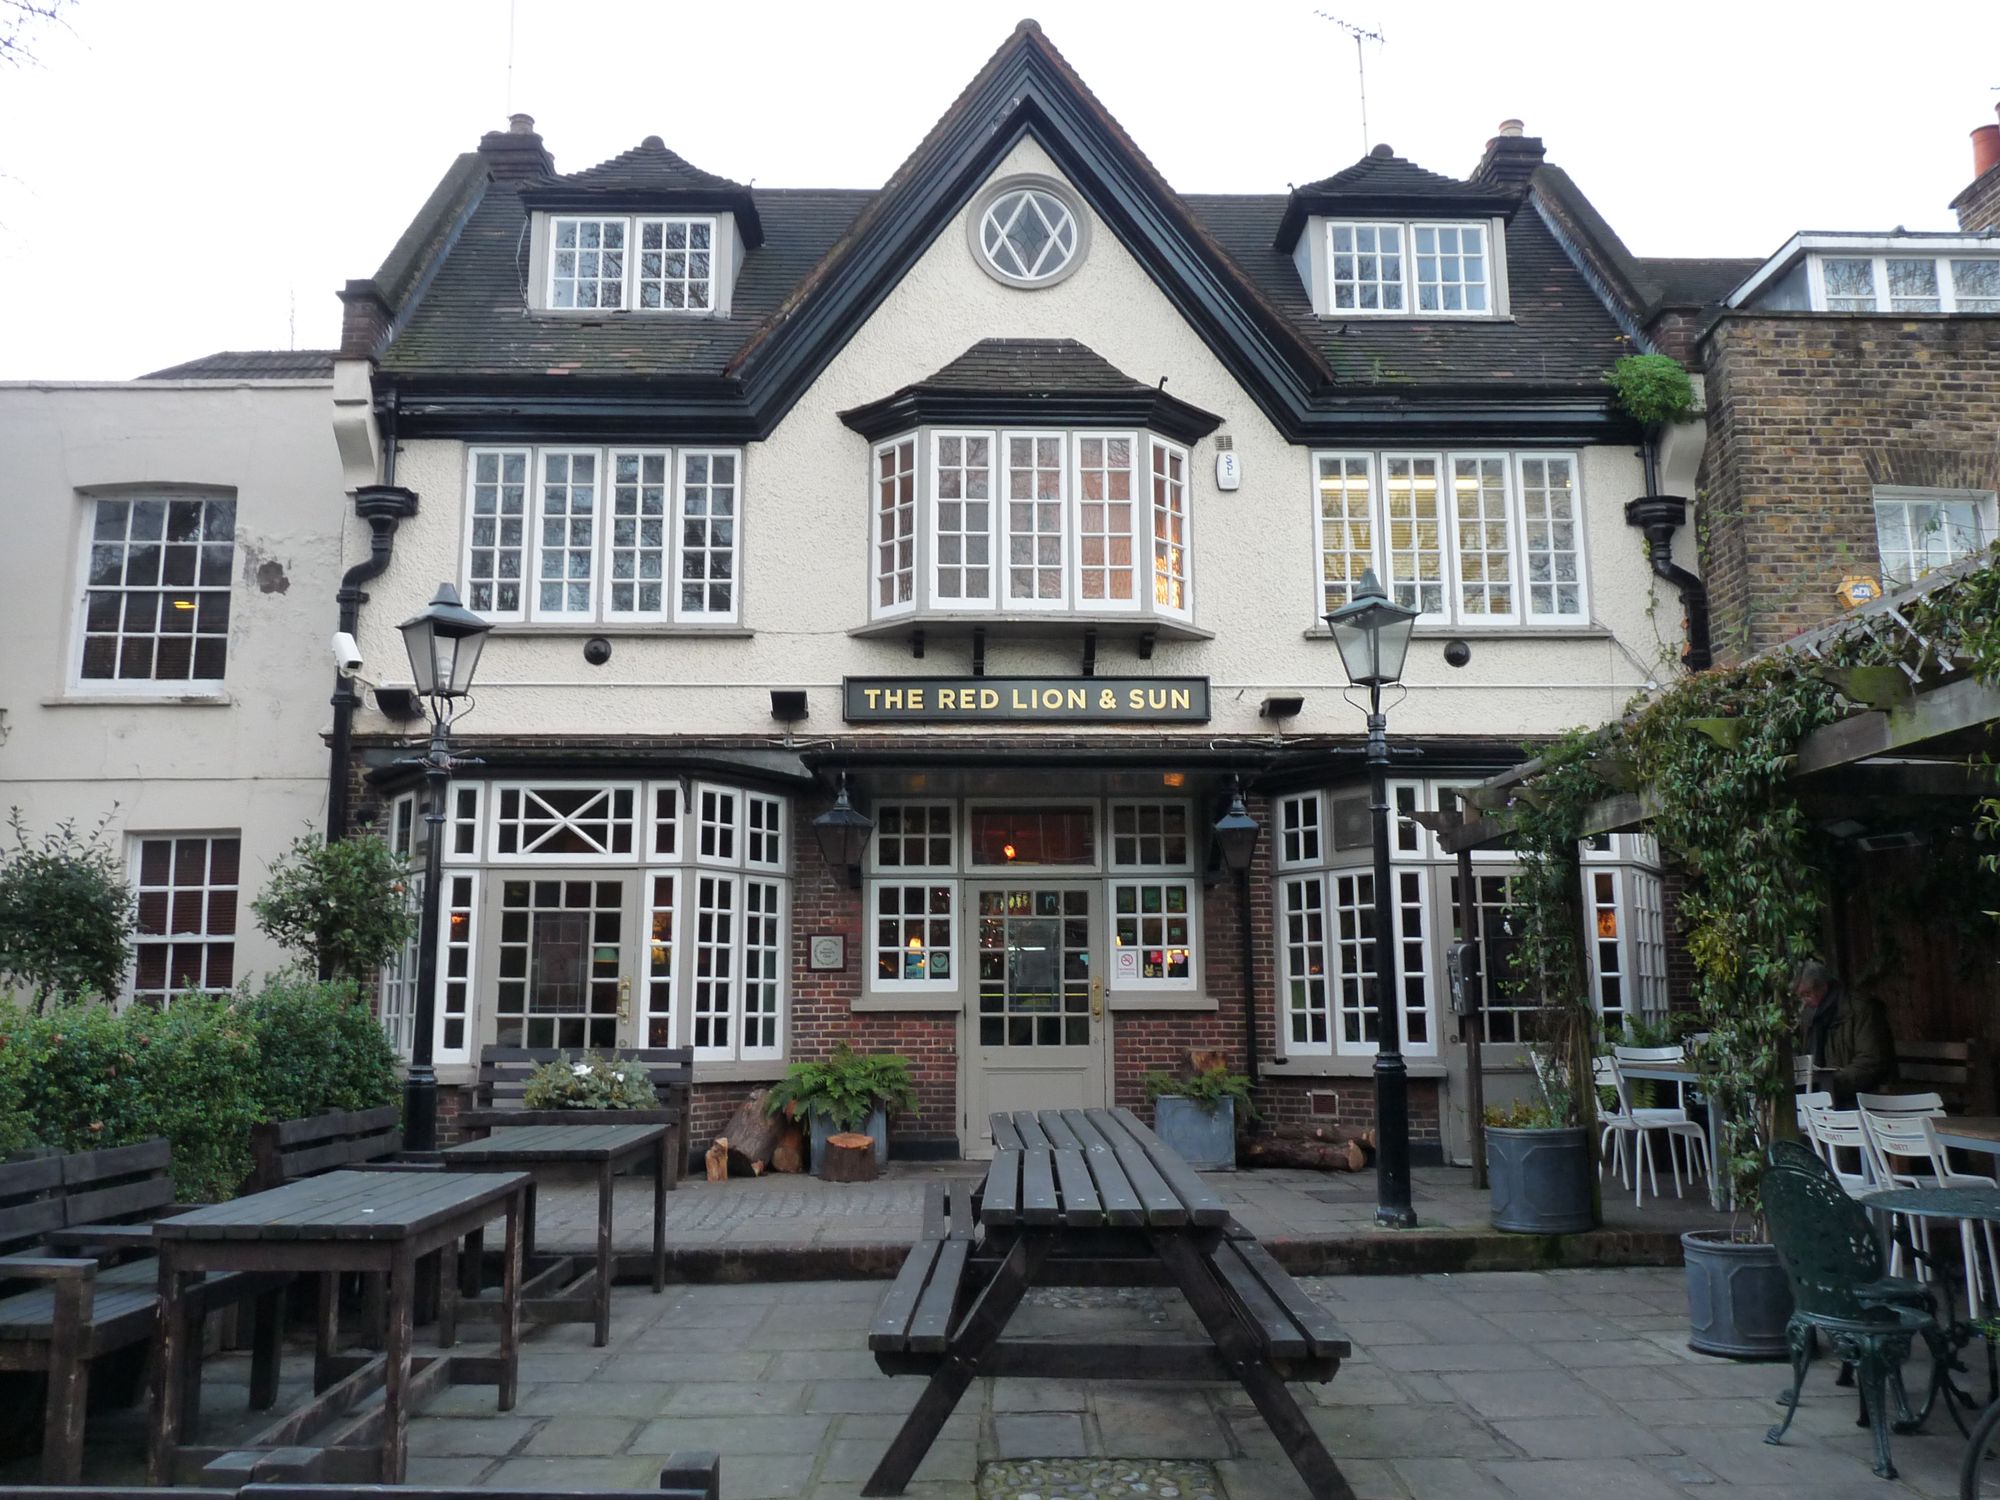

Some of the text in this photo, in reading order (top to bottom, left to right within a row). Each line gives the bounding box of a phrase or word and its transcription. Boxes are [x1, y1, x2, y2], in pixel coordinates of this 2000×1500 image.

[864, 689, 1190, 710] THE RED LION & SUN
